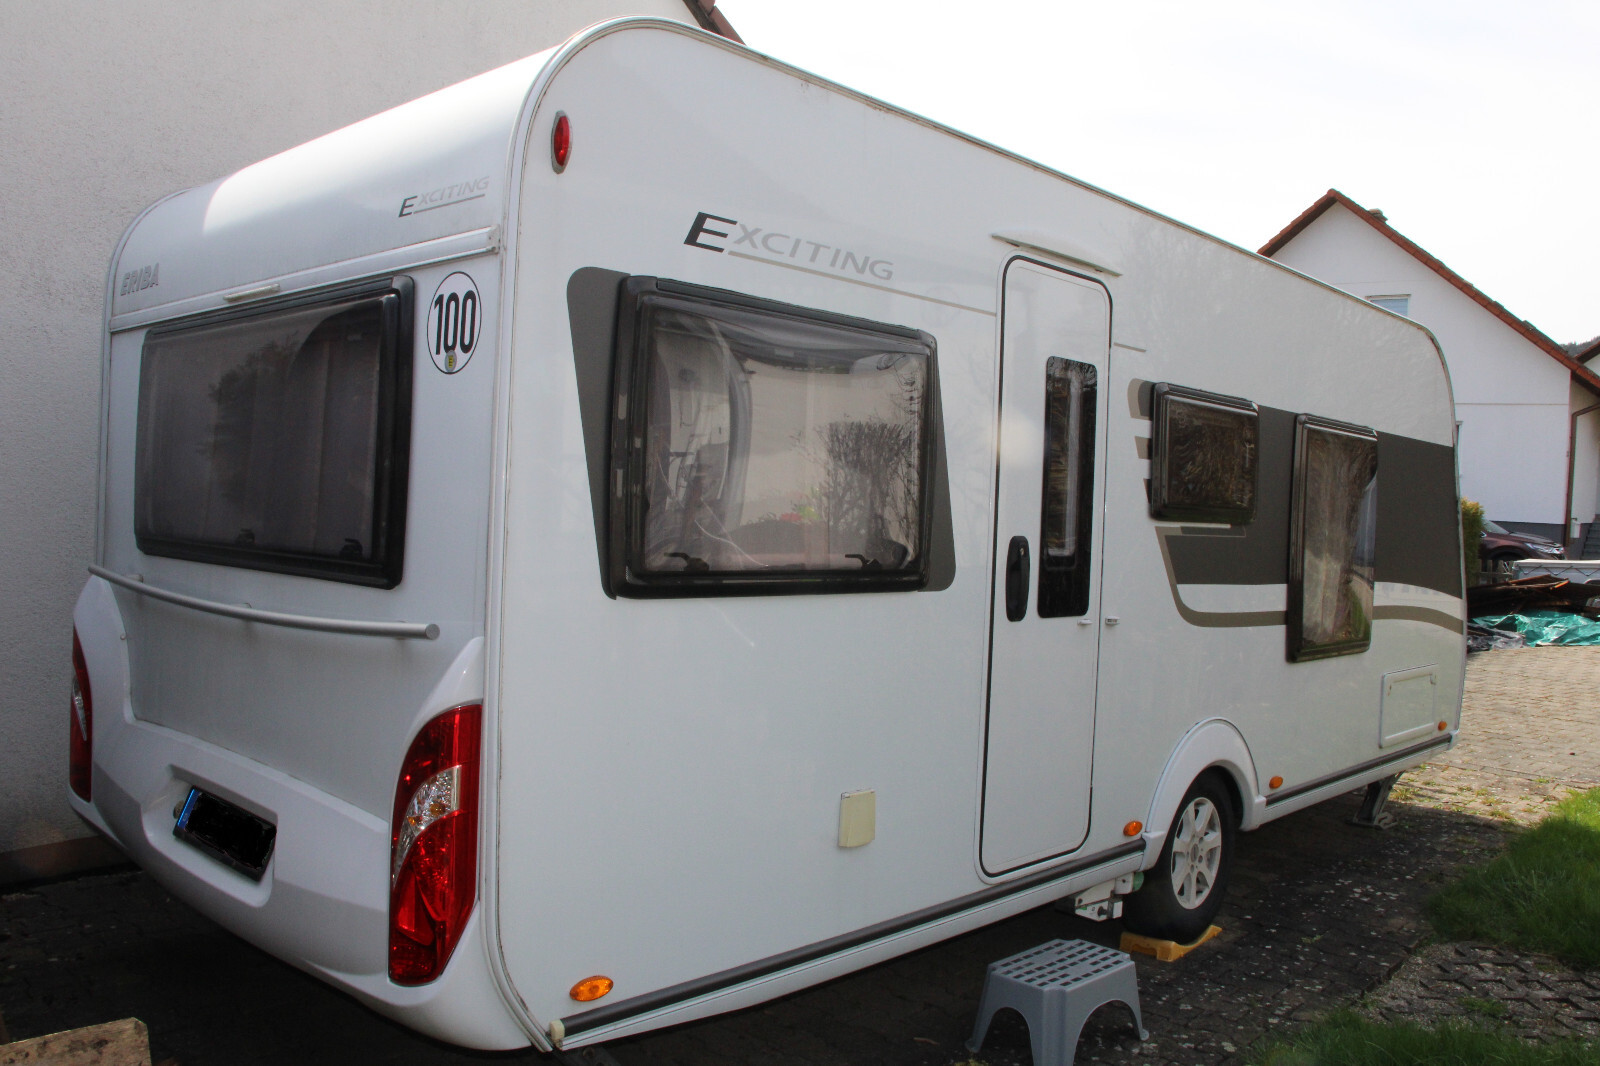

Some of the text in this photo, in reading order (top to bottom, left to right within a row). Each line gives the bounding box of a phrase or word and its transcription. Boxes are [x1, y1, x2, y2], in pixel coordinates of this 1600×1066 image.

[398, 176, 490, 218] EXCITING
[683, 211, 895, 281] EXCITING
[120, 262, 160, 297] ERIBA
[434, 290, 476, 355] 100
